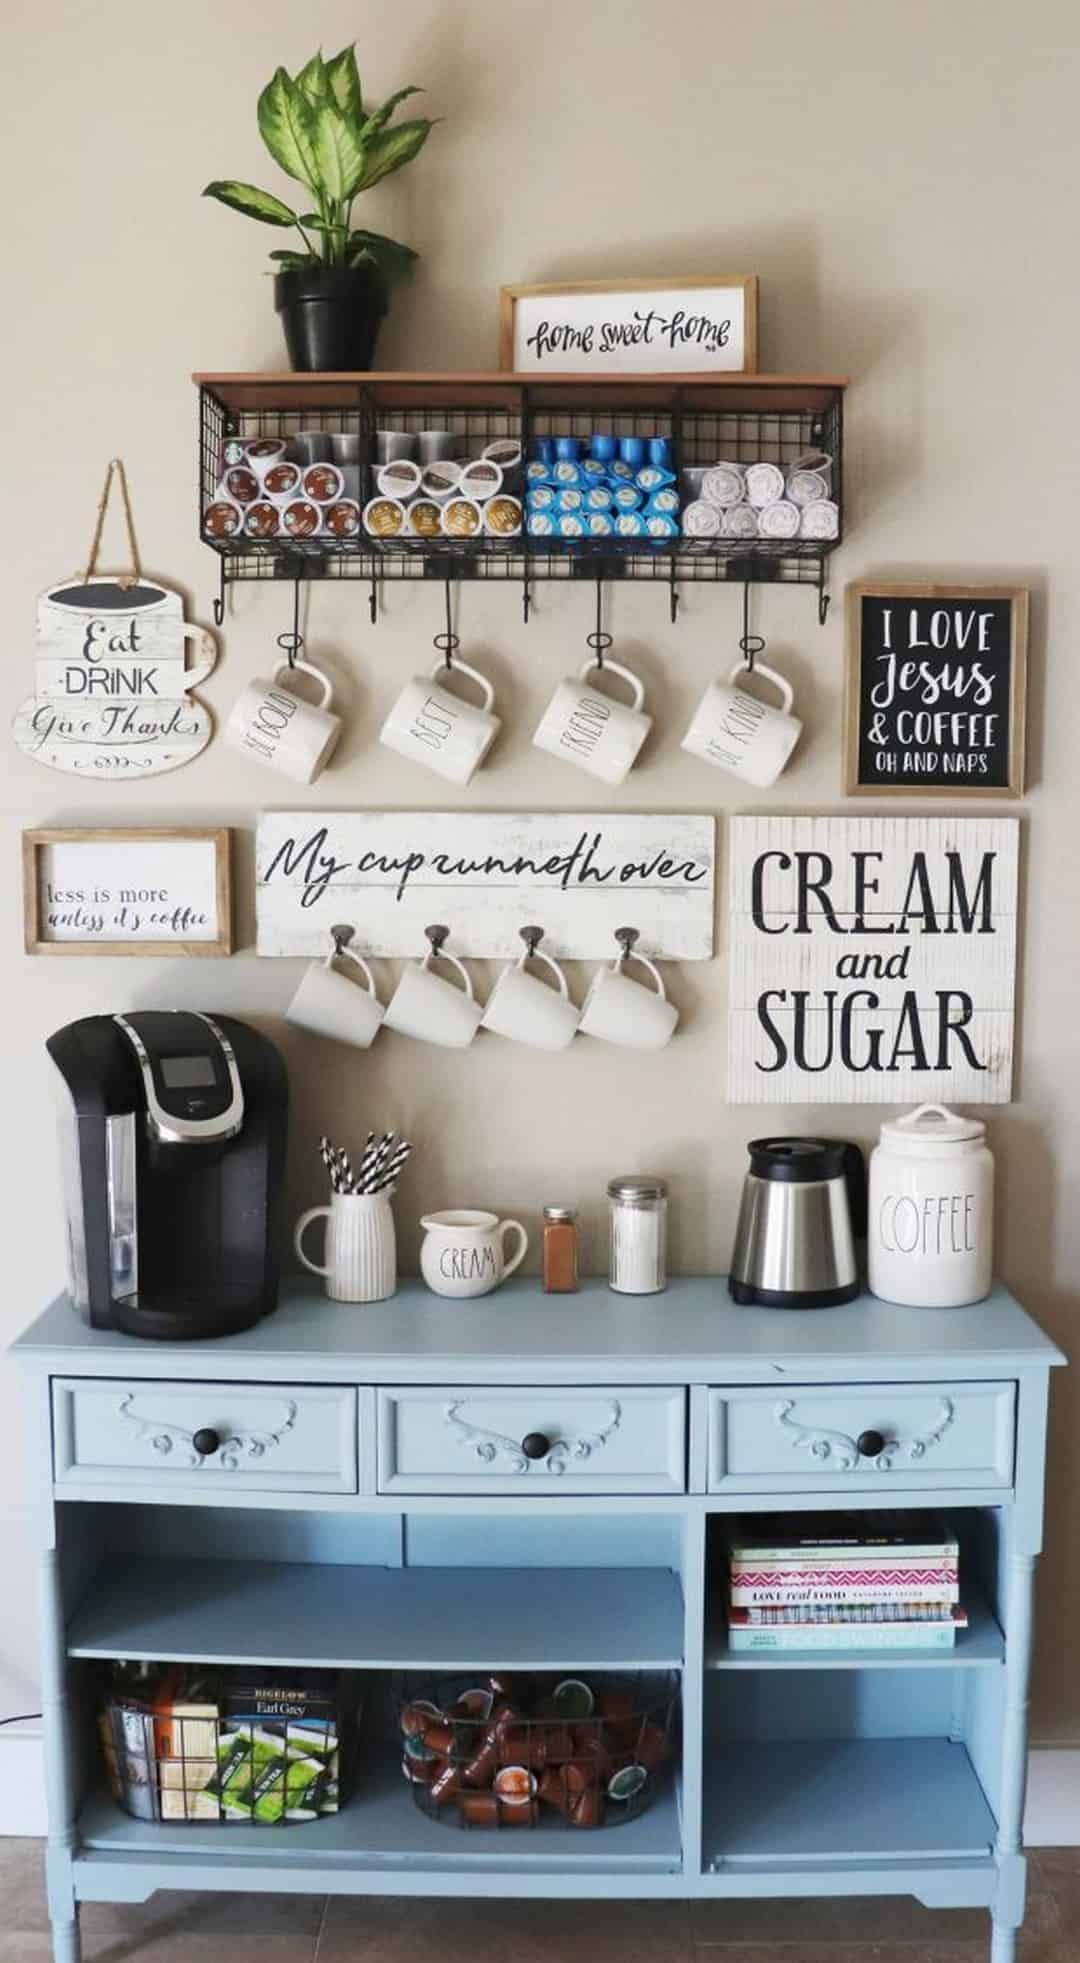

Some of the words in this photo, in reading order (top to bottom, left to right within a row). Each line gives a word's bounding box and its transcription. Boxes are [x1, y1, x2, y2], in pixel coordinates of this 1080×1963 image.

[527, 321, 594, 358] home
[600, 312, 667, 352] sweet
[661, 311, 731, 348] home
[83, 618, 142, 662] Eat
[882, 609, 892, 649] I
[908, 609, 995, 652] LOVE
[871, 653, 996, 708] Jesus
[31, 705, 93, 752] Give
[101, 705, 202, 737] Thanks
[409, 695, 459, 750] BEST
[559, 697, 612, 758] FRIEND
[720, 695, 767, 745] KIND
[867, 712, 890, 746] &
[897, 710, 1000, 748] COFFEE
[875, 752, 898, 774] OH
[903, 752, 938, 773] AND
[943, 752, 988, 774] NAPS
[263, 827, 352, 909] My
[357, 848, 426, 902] cup
[432, 832, 616, 890] runneth
[618, 849, 708, 884] over
[48, 884, 85, 904] less
[95, 887, 111, 903] is
[119, 888, 169, 903] more
[751, 851, 998, 935] CREAM
[48, 907, 104, 932] unless
[150, 907, 208, 932] coffee
[836, 945, 912, 980] and
[755, 989, 987, 1073] SUGAR
[879, 1194, 976, 1256] COFFEE
[439, 1247, 497, 1280] CREAM
[254, 1688, 306, 1700] BIGELOW
[256, 1701, 278, 1714] Earl
[279, 1703, 306, 1716] Grey
